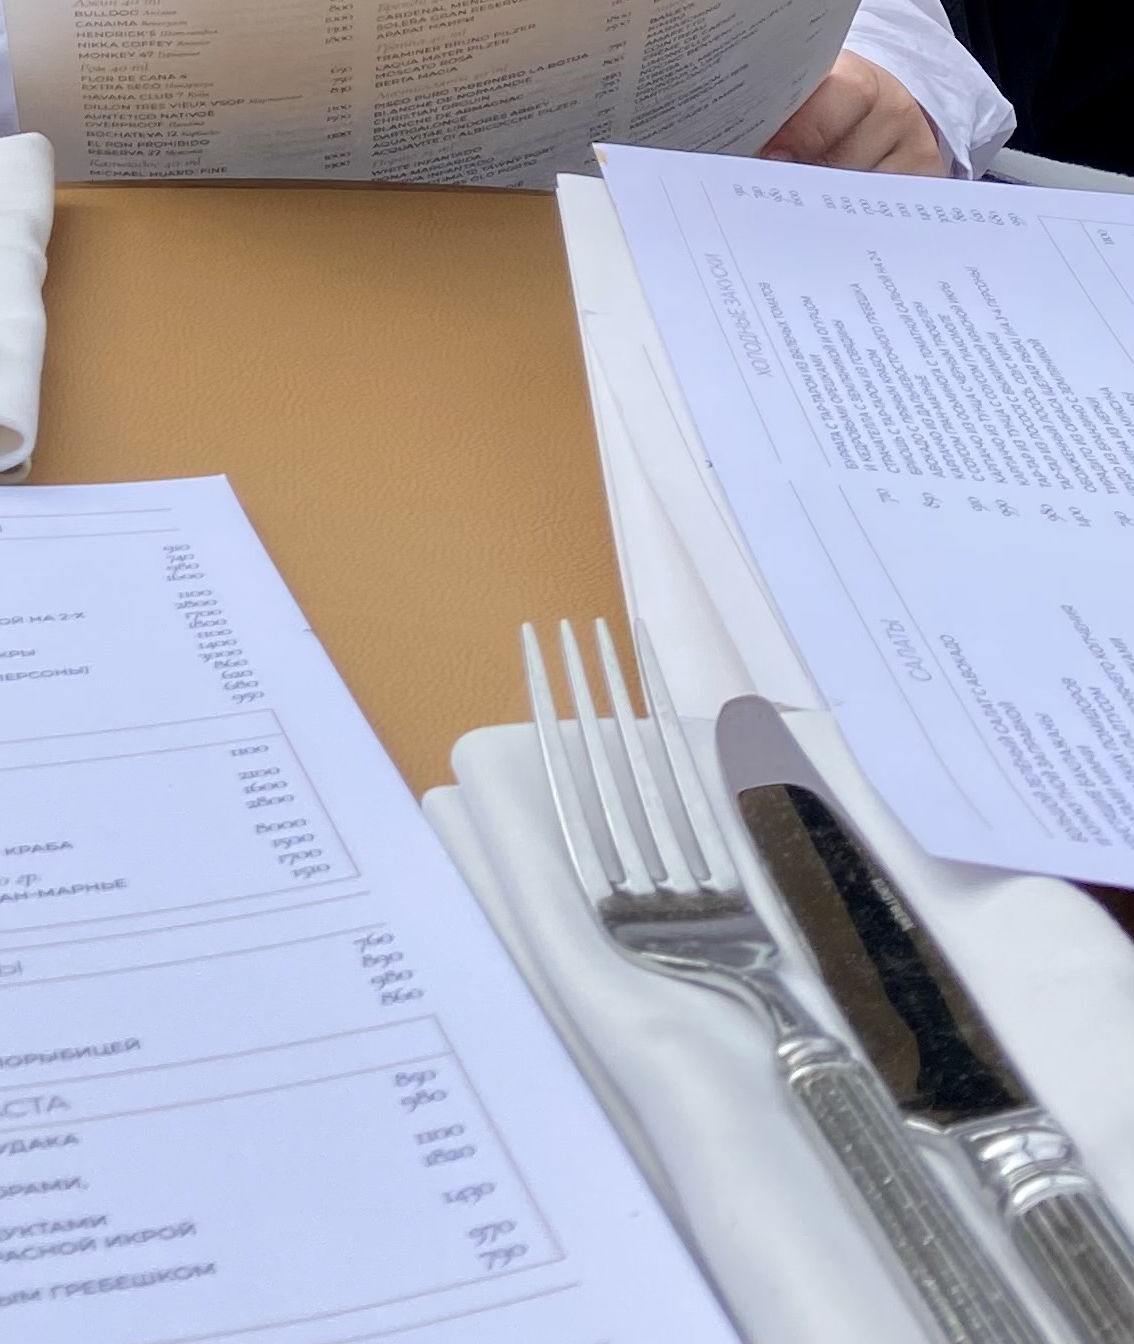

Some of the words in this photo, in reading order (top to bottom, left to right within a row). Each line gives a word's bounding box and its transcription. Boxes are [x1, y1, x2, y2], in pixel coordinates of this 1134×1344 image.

[74, 9, 139, 18] BULLDOG
[78, 50, 135, 59] MONKEY
[702, 252, 741, 305] ЗАКУСКИ
[726, 308, 775, 377] ХОЛОДНЫЕ
[878, 618, 934, 682] САЛАТЫ
